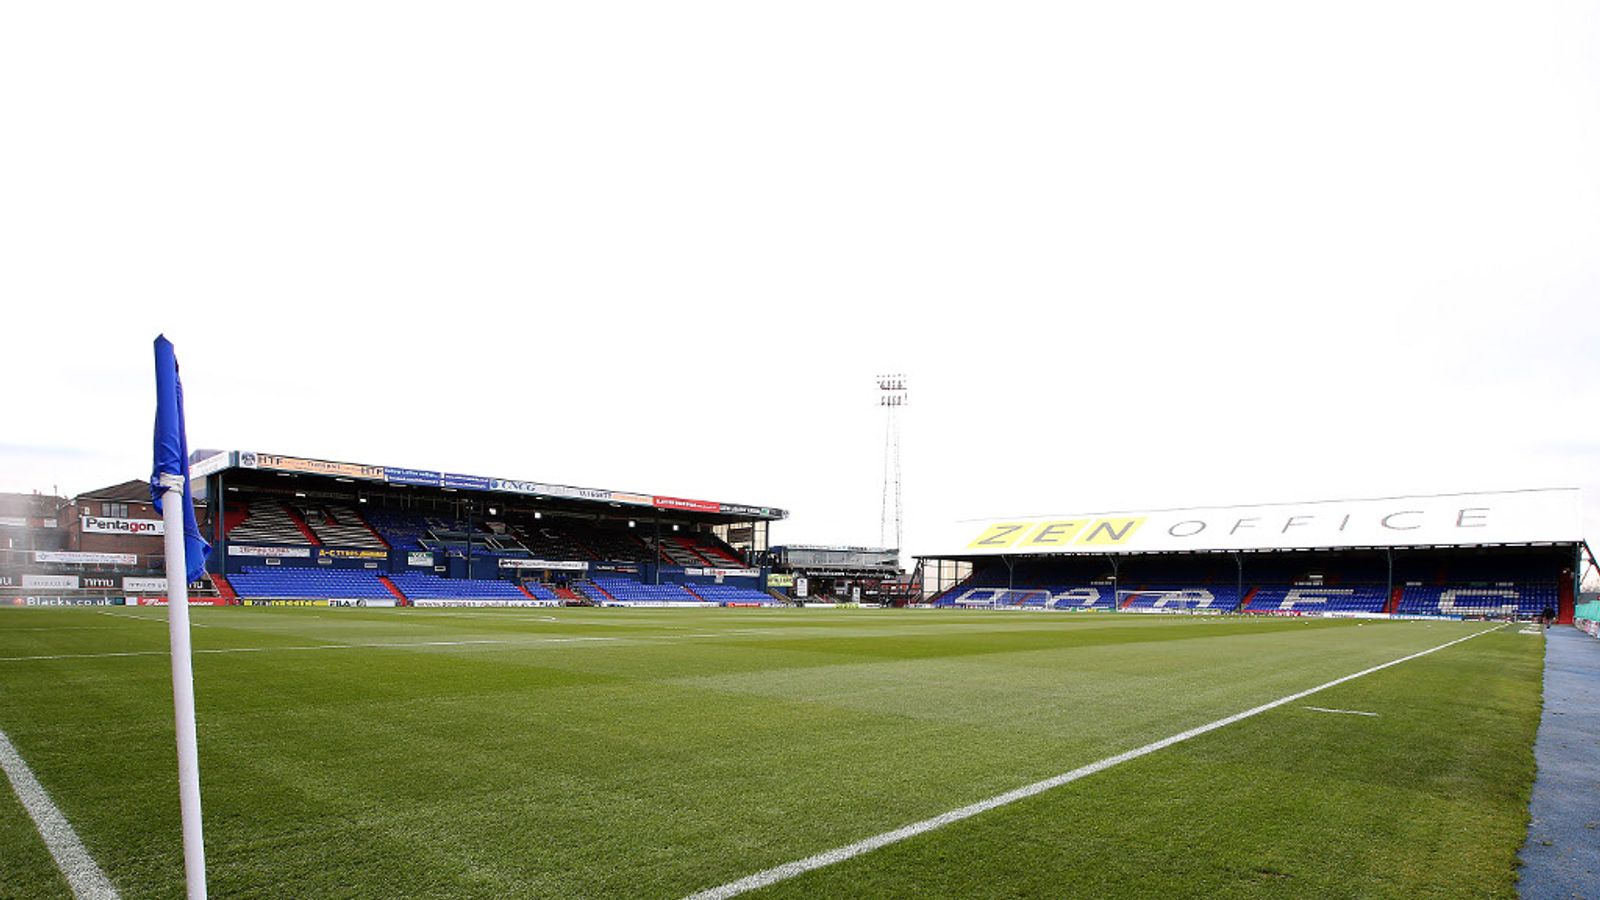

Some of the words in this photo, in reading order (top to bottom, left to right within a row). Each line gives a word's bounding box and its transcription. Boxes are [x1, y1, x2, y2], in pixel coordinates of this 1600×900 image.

[86, 517, 156, 532] Pentagon
[977, 521, 1135, 545] ZEN
[1169, 508, 1490, 537] OFFICE
